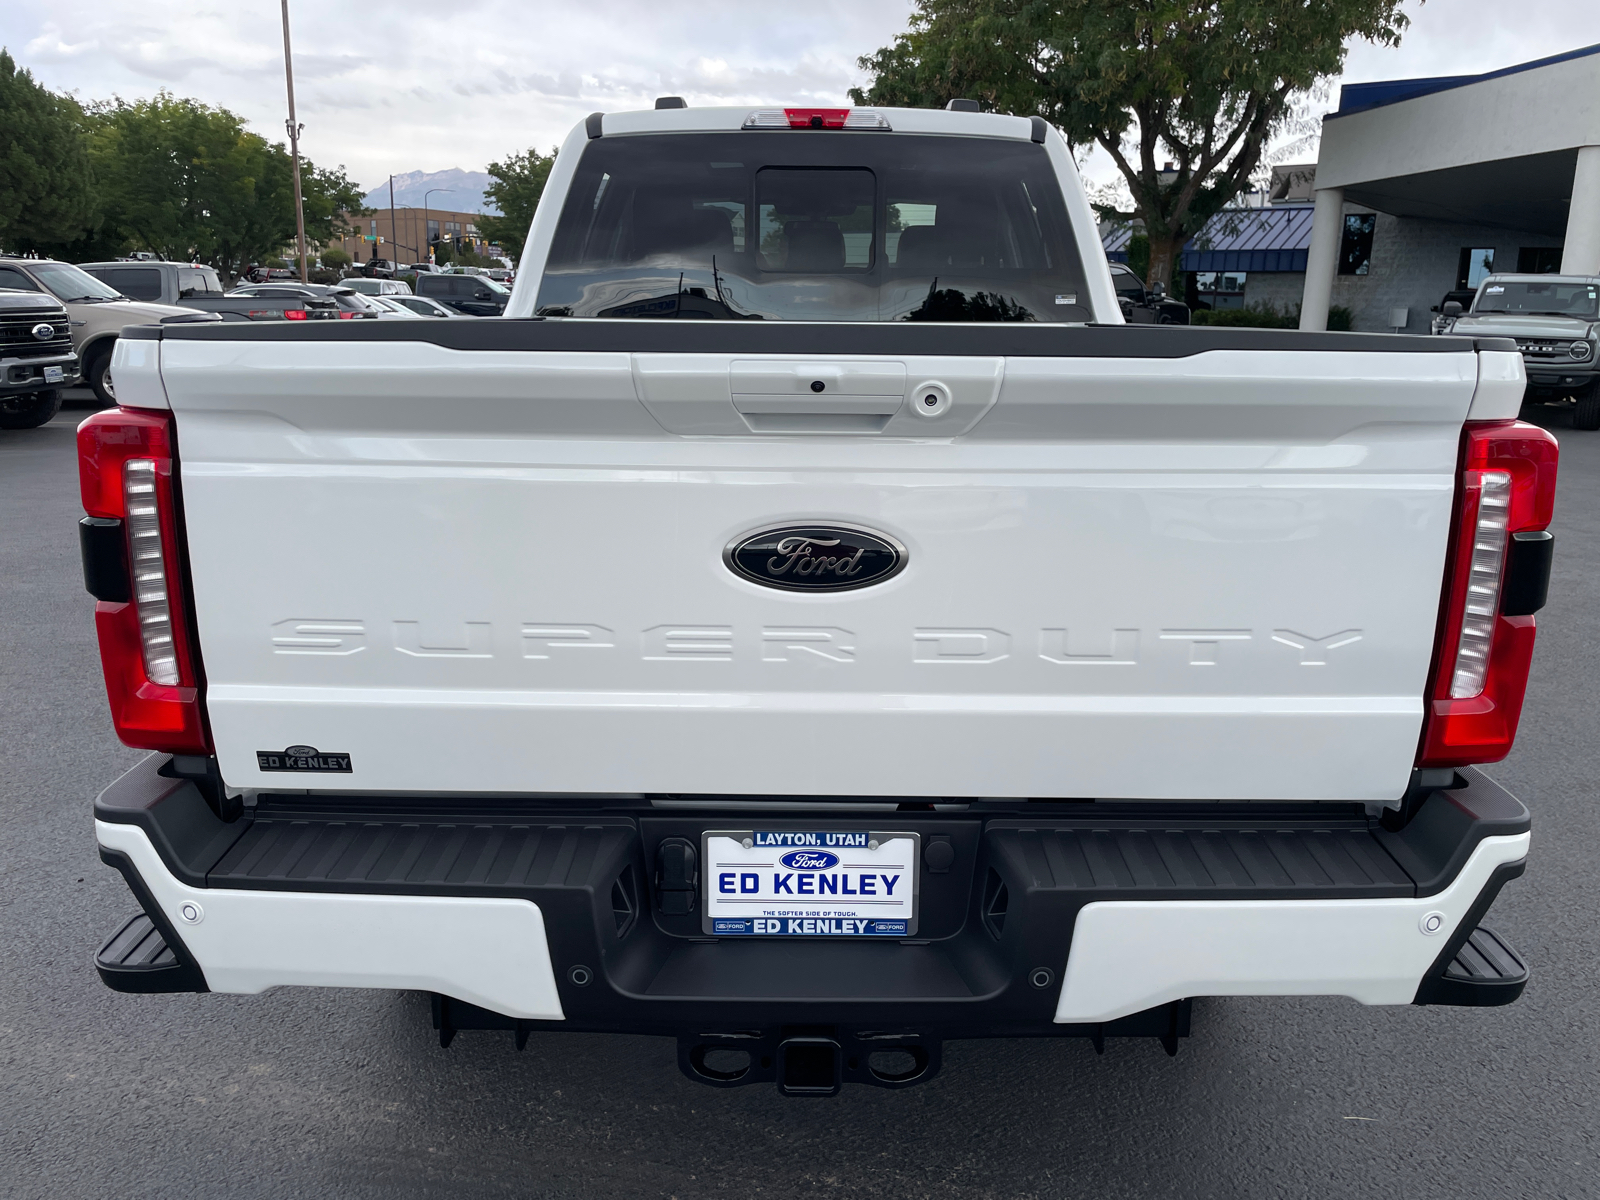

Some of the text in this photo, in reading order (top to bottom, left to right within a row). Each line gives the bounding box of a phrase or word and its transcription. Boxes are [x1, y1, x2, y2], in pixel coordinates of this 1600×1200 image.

[766, 536, 865, 576] Ford
[272, 618, 1364, 666] SUPER DUTY
[292, 748, 311, 756] Ford
[259, 756, 349, 769] ED KENLEY
[756, 833, 866, 846] LAYTON, UTAH
[791, 852, 829, 868] Ford
[718, 872, 901, 896] ED KENLEY
[753, 919, 869, 934] ED KENLEY
